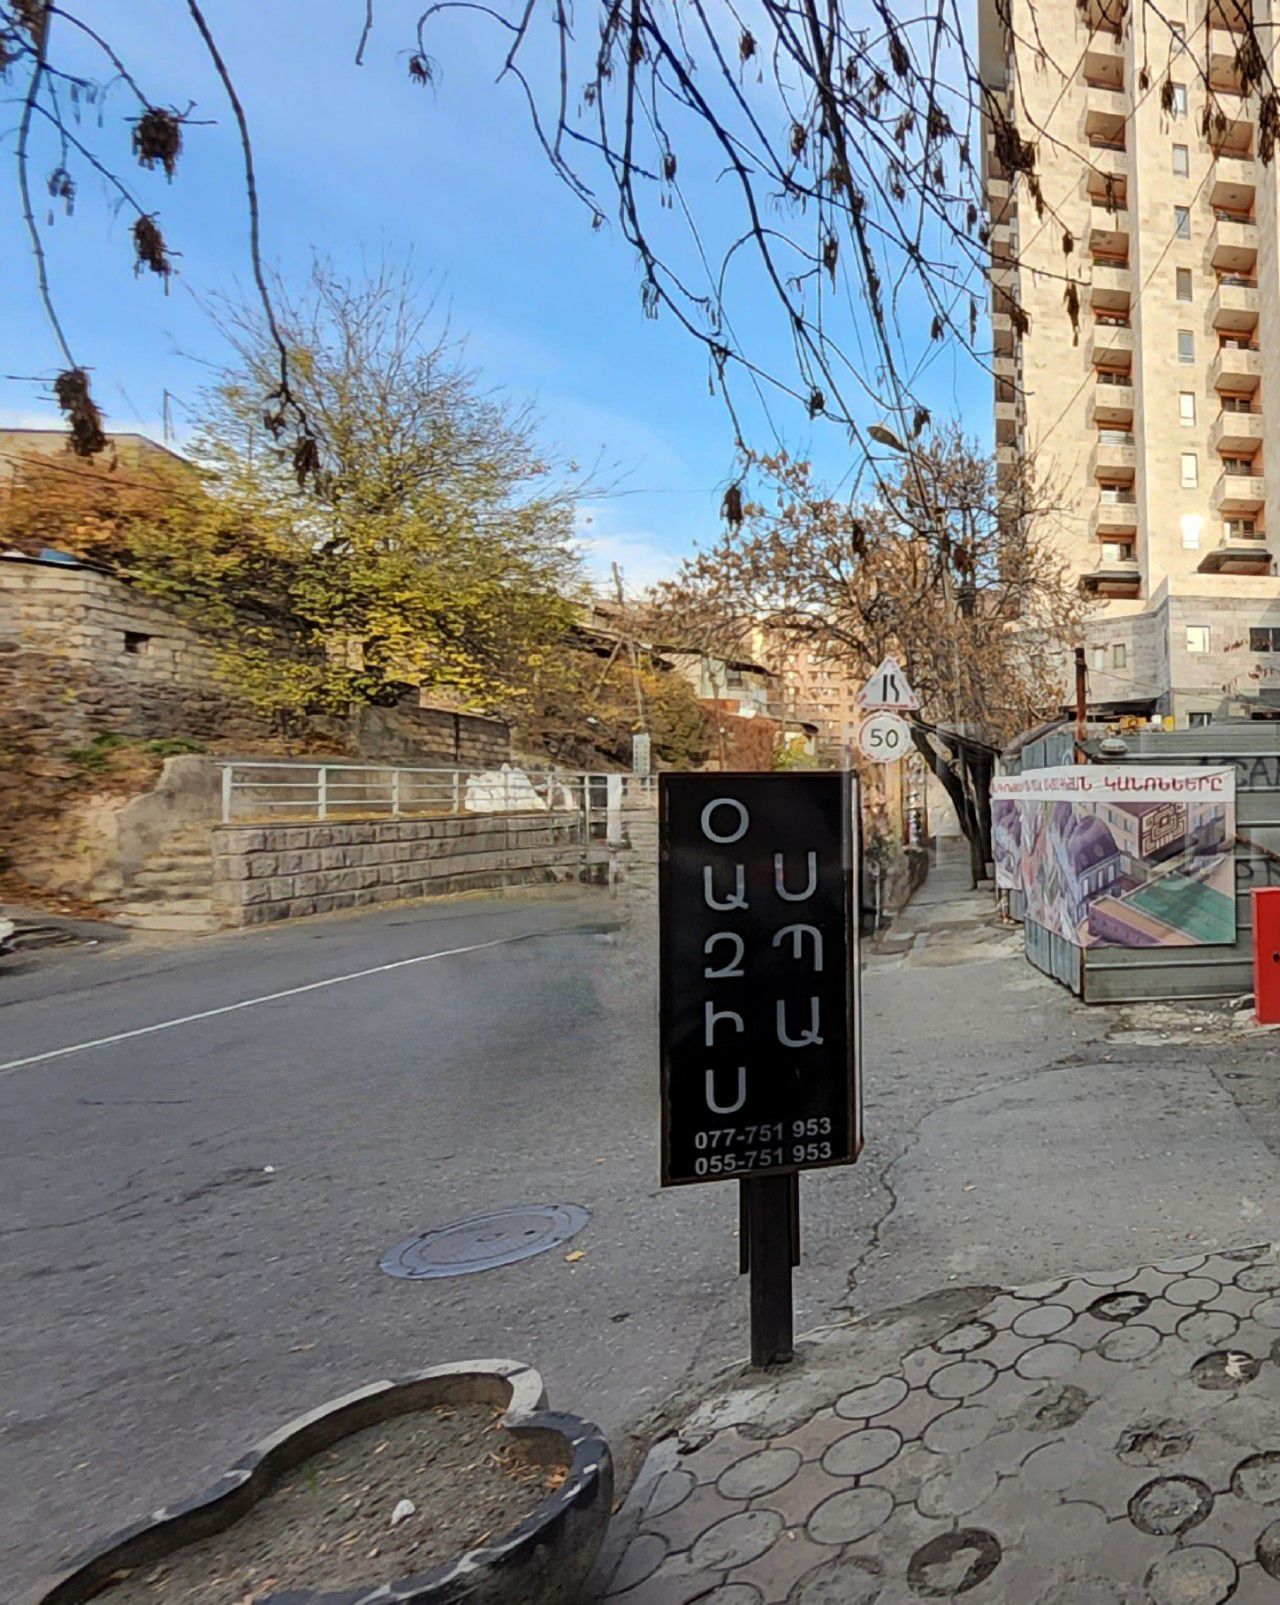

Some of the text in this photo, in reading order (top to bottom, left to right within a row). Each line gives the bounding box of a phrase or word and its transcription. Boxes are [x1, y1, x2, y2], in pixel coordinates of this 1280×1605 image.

[869, 728, 899, 748] 50
[694, 1116, 832, 1150] 077-751 953
[694, 1141, 832, 1175] 055-751 953
